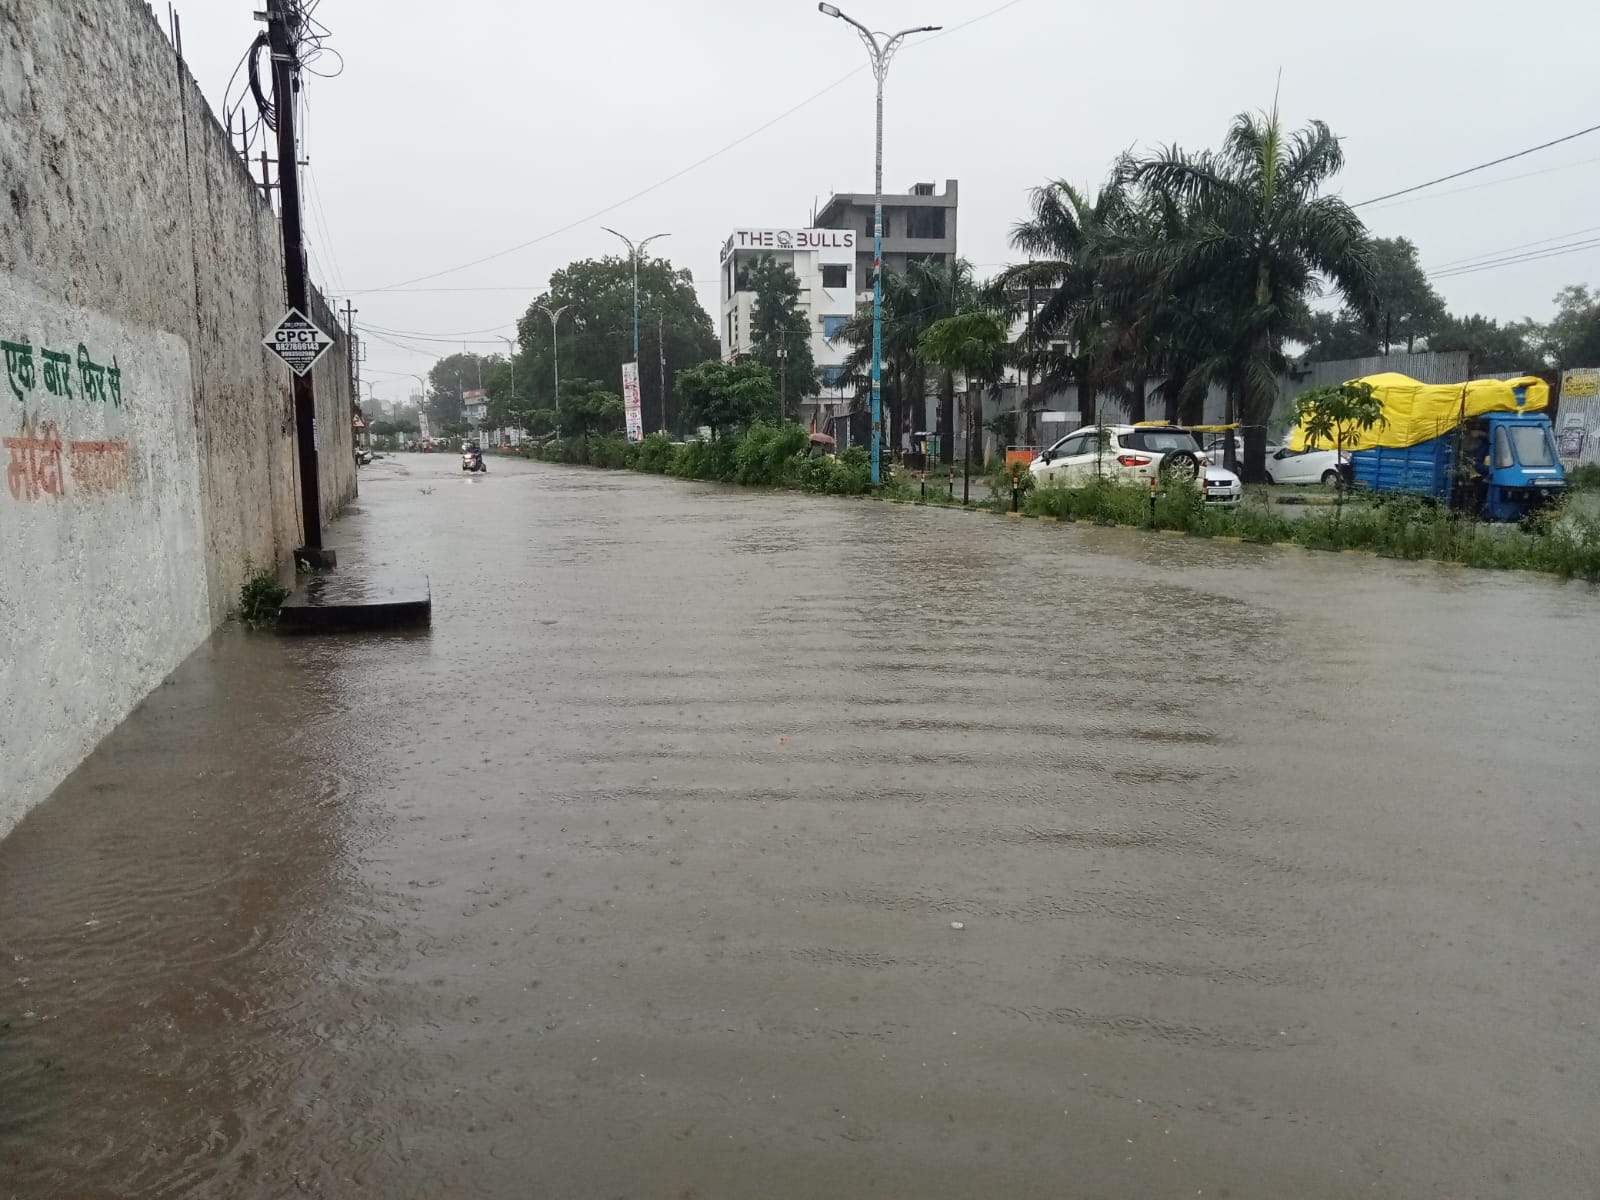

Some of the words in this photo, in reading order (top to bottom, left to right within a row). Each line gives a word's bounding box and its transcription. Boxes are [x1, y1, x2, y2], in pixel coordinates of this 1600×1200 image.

[737, 231, 774, 246] THE
[797, 232, 853, 247] BULLS
[275, 331, 318, 342] CPCT
[1, 340, 36, 401] एक
[41, 347, 73, 400] बार
[78, 342, 106, 402] फिर
